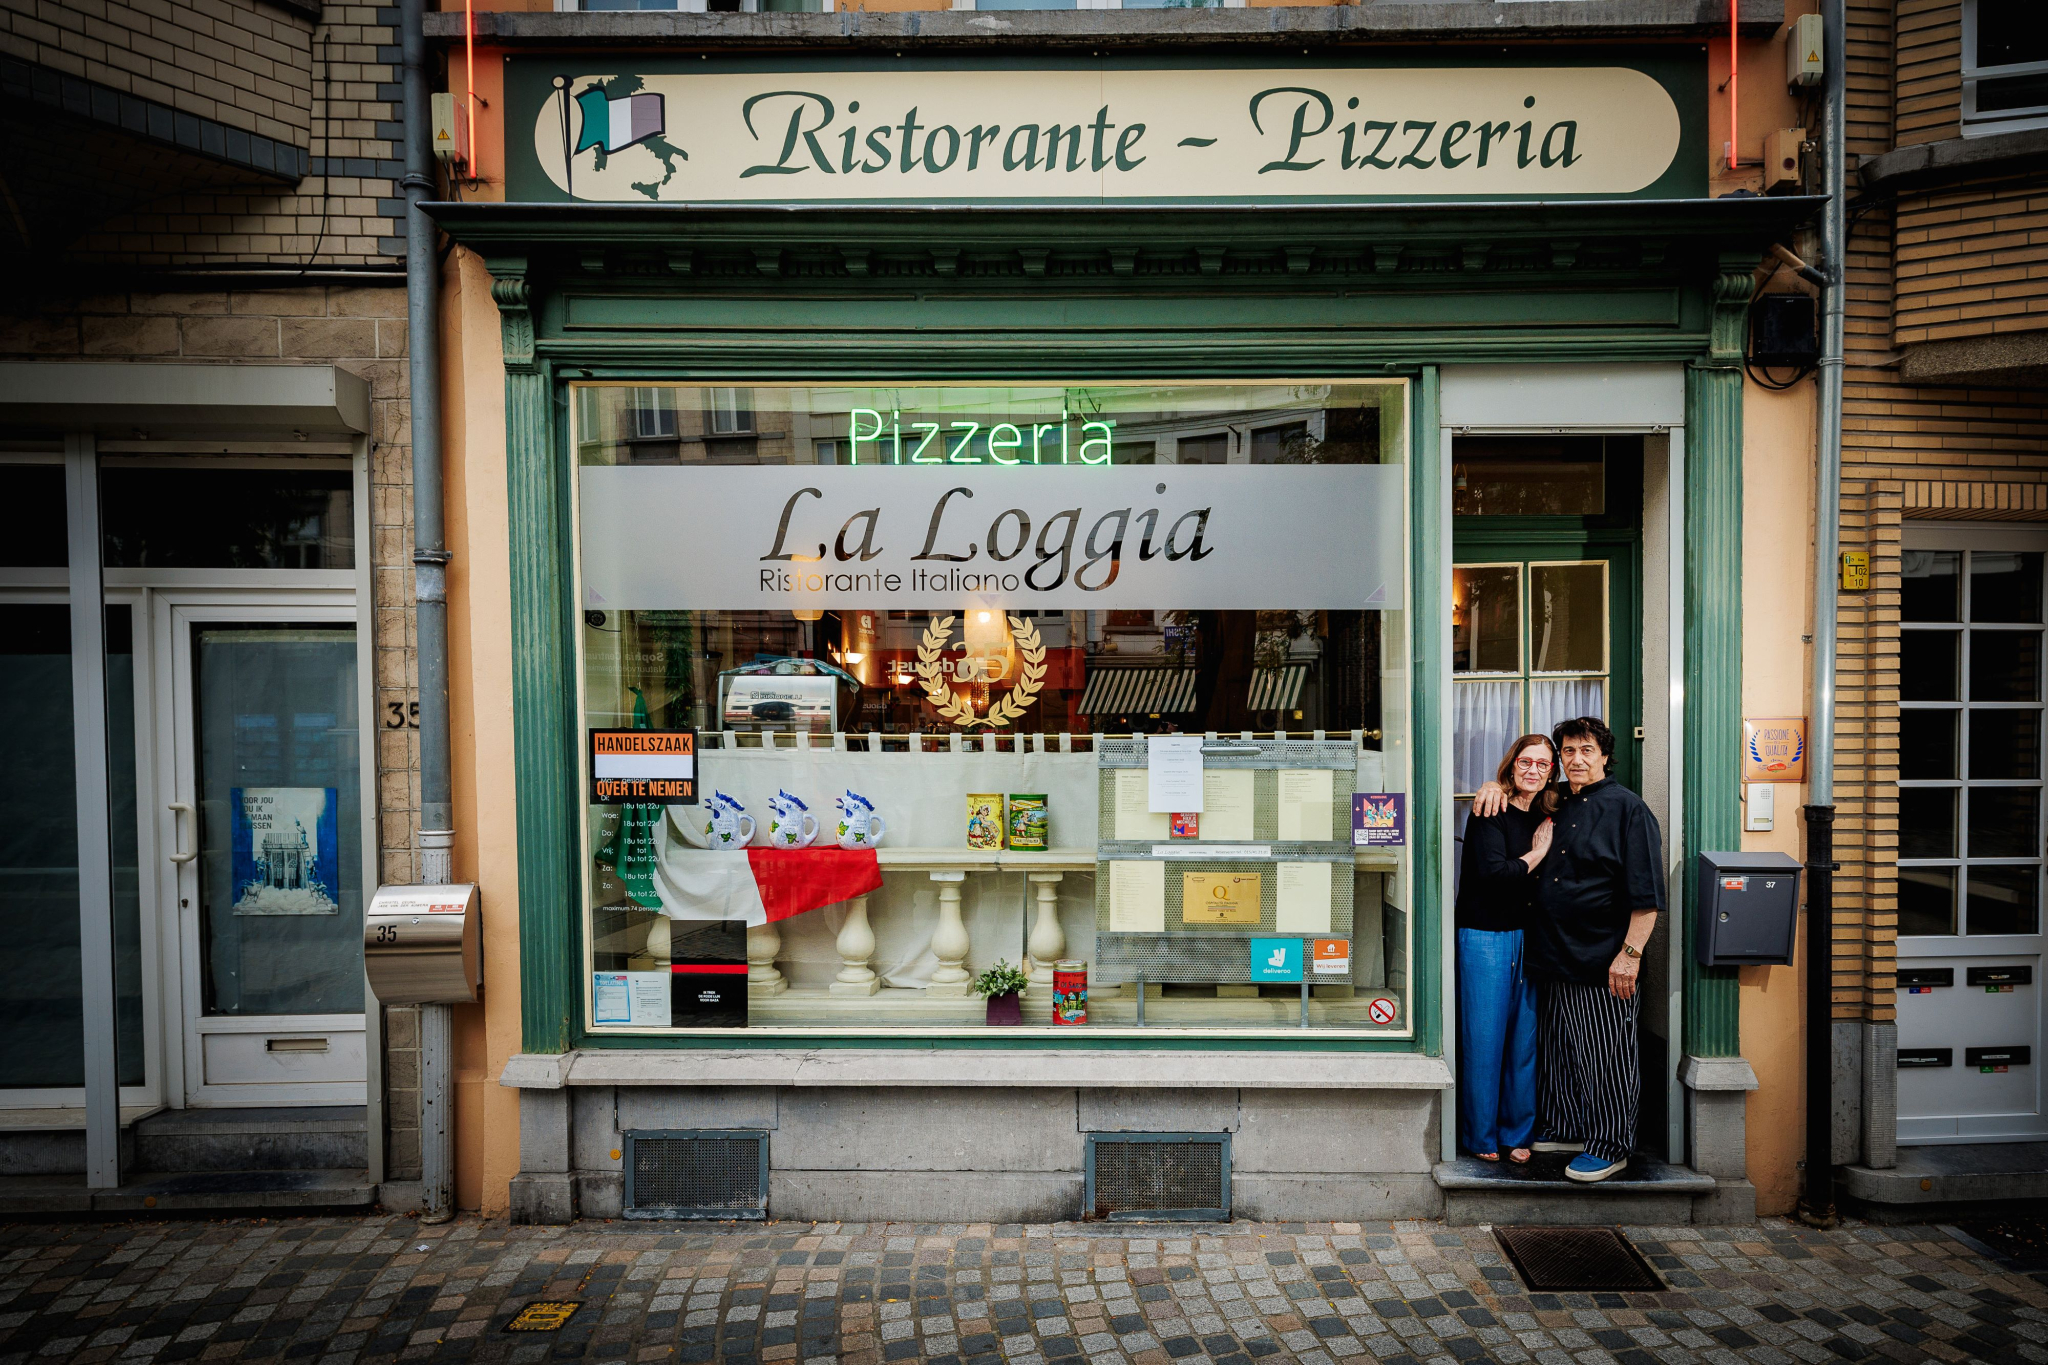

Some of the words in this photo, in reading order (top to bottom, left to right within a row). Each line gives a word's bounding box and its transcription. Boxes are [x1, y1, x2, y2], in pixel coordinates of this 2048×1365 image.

[739, 91, 1147, 178] Ristorante
[1249, 87, 1582, 175] Pizzeria
[850, 406, 1114, 465] Pizzeria
[758, 486, 884, 562] La
[910, 483, 1214, 591] Loggia
[758, 568, 901, 592] Ristorante
[912, 568, 1019, 592] Italiano
[1854, 578, 1864, 587] 10
[951, 641, 1012, 684] 35
[386, 701, 420, 729] 35
[597, 736, 690, 752] HANDELSZAAK
[1764, 729, 1789, 740] PASSIONE
[597, 781, 629, 796] OVER
[633, 781, 646, 796] TE
[649, 781, 692, 797] NEMEN
[1213, 885, 1230, 900] Q
[376, 925, 397, 942] 35
